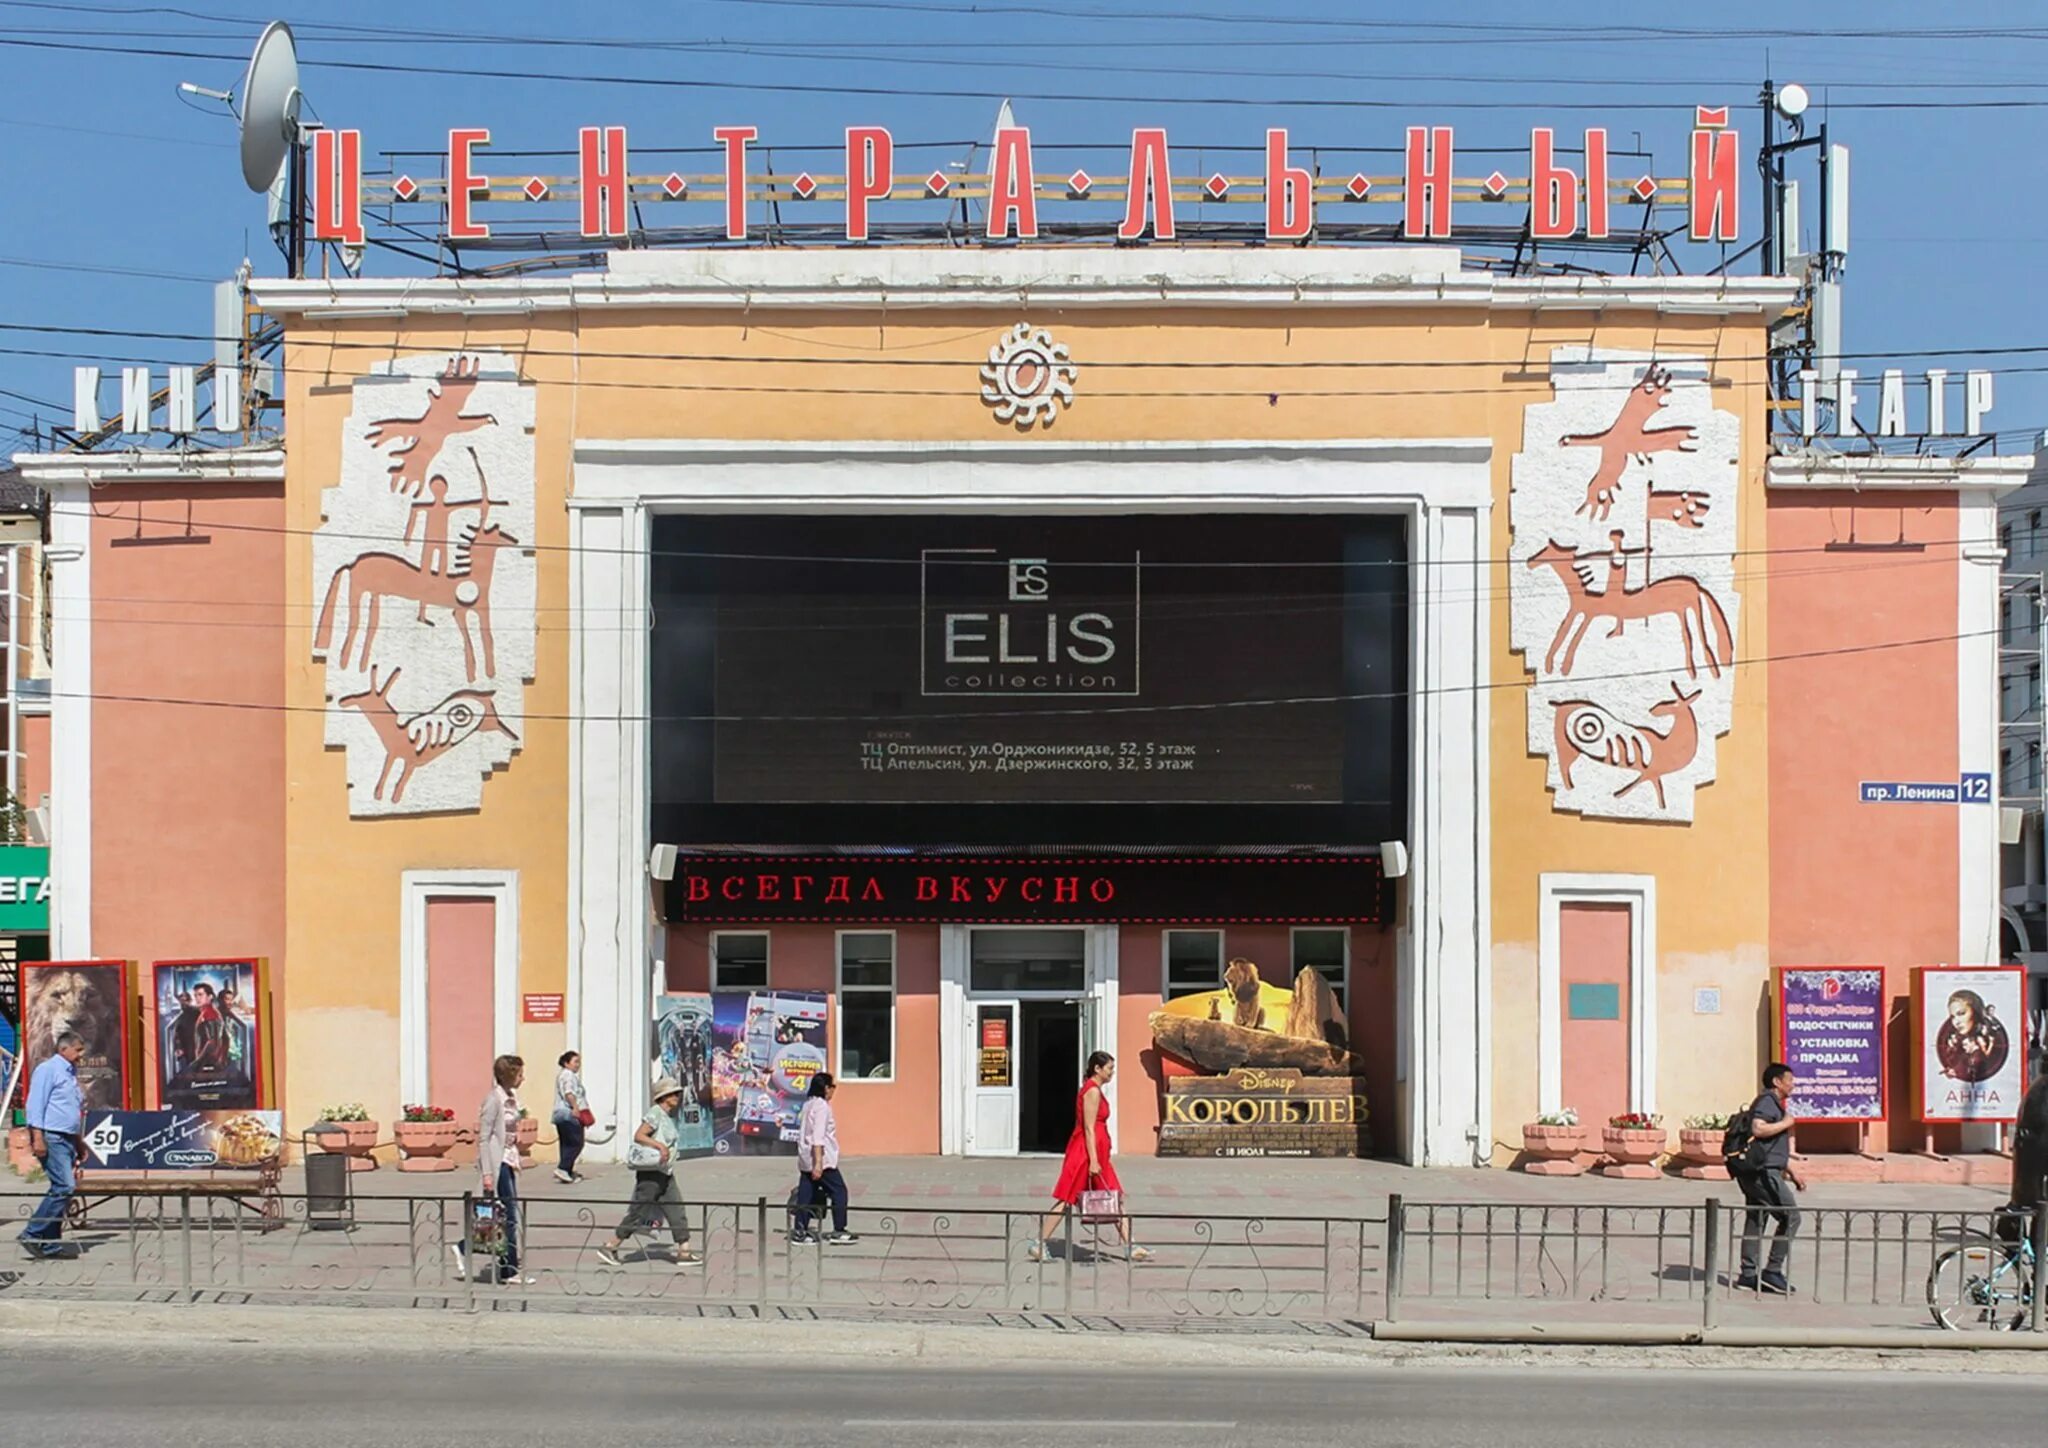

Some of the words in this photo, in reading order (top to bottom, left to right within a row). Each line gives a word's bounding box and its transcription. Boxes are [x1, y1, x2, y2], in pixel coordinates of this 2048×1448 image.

[313, 105, 1740, 246] ЦЕНТРАЛЬНЫЙ
[75, 366, 241, 433] КИНО
[1799, 368, 1994, 437] ТЕАТР
[945, 612, 1117, 664] ELIS
[945, 673, 1117, 688] collection
[860, 742, 883, 757] ТЦ
[887, 742, 967, 756] Оптимист,
[1119, 742, 1141, 756] 52,
[1158, 744, 1196, 756] этаж
[860, 757, 883, 772] ТЦ
[887, 757, 966, 771] Апельсин,
[968, 758, 991, 772] ул.
[995, 757, 1113, 772] Дзержинского,
[1117, 757, 1140, 772] 32,
[1144, 757, 1153, 770] 3
[1156, 758, 1193, 770] этаж
[1866, 786, 1892, 801] пр.
[1895, 785, 1956, 800] Ленина
[1962, 778, 1989, 798] 12
[916, 876, 1115, 903] ВКУСНО
[1788, 1020, 1874, 1032] ВОДОСЧЕТЧИКИ
[1799, 1038, 1870, 1049] УСТАНОВКА
[1799, 1053, 1860, 1065] ПРОДАЖА
[791, 1074, 806, 1091] 4
[1944, 1089, 2001, 1104] АННА
[1164, 1094, 1299, 1124] КОРОЛЬ
[1306, 1094, 1370, 1124] ЛЕВ
[94, 1130, 119, 1146] 50
